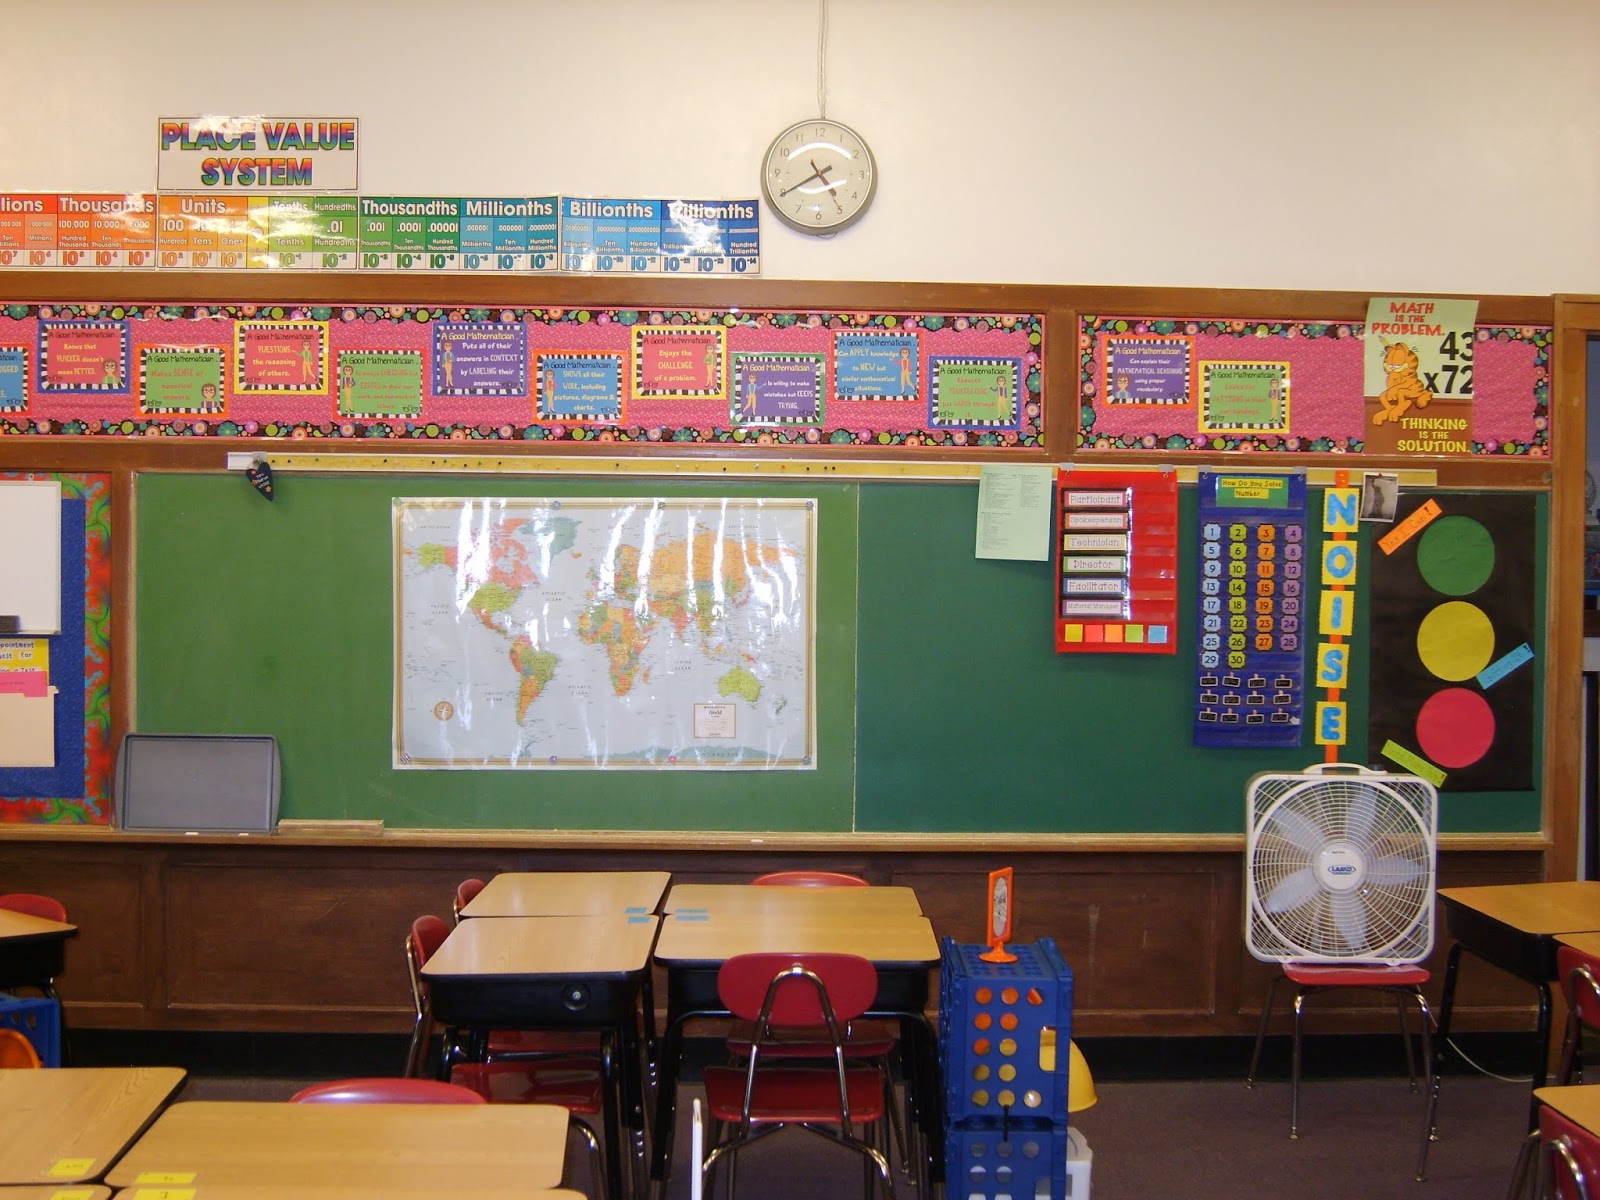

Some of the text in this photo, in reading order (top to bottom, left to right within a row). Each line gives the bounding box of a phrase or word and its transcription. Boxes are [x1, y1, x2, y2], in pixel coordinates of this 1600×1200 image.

[161, 122, 355, 150] PLACE VALUE
[796, 133, 804, 142] 11
[815, 128, 826, 138] 12
[780, 148, 790, 157] 10
[853, 149, 859, 159] 2
[201, 158, 313, 186] SYSTEM
[774, 168, 781, 177] 9
[859, 170, 865, 180] 3
[851, 191, 858, 200] 4
[60, 197, 154, 213] Thousands
[181, 198, 227, 214] Units
[314, 203, 357, 212] Hundredths
[362, 199, 458, 215] Thousandths
[466, 200, 553, 216] Millionths
[570, 201, 654, 218] Billionths
[795, 204, 802, 214] 7
[667, 202, 755, 219] Trillionths
[836, 206, 843, 215] 5
[815, 211, 822, 220] 6
[163, 219, 185, 232] 100
[327, 221, 343, 233] .01
[367, 222, 385, 232] .001
[397, 222, 422, 233] .0001
[427, 222, 458, 233] .00001
[159, 237, 188, 245] Hundreds
[193, 237, 213, 245] Tens
[276, 238, 305, 246] Tenths
[314, 238, 356, 246] Hundredths
[1390, 302, 1434, 314] MATH
[1395, 314, 1426, 323] IS THE
[1371, 322, 1446, 336] PROBLEM.
[441, 332, 447, 340] A
[257, 345, 291, 353] QUESTIONS
[1439, 331, 1473, 362] 43
[659, 349, 680, 358] Enjoys
[265, 359, 296, 367] reasoning
[658, 361, 693, 369] CHALLENGE
[469, 367, 497, 375] LABELING
[1424, 365, 1473, 394] x72
[1401, 417, 1468, 430] THINKING
[1419, 431, 1449, 439] IS THE
[1397, 440, 1471, 453] SOLUTION.
[1070, 494, 1121, 506] Participant
[1070, 516, 1122, 526] Spokesperson
[1235, 528, 1241, 537] 2
[1263, 529, 1269, 537] 3
[1290, 529, 1296, 537] 4
[1070, 537, 1120, 548] Technician
[1209, 546, 1215, 554] 5
[1235, 547, 1241, 555] 6
[1264, 548, 1269, 556] 7
[1290, 548, 1296, 556] 8
[1073, 559, 1114, 569] Director
[1209, 564, 1216, 573] 9
[1233, 565, 1243, 573] 10
[1262, 566, 1269, 574] 11
[1288, 567, 1297, 575] 12
[1069, 581, 1119, 592] Facilitator
[1206, 582, 1216, 591] 13
[1232, 583, 1242, 591] 14
[1261, 584, 1270, 592] 15
[1287, 584, 1296, 592] 16
[1207, 601, 1216, 609] 17
[1233, 601, 1242, 609] 18
[1260, 601, 1269, 609] 19
[1285, 602, 1296, 610] 20
[1207, 619, 1217, 628] 21
[1233, 619, 1244, 628] 22
[1260, 620, 1270, 628] 23
[1284, 620, 1295, 628] 24
[1206, 638, 1217, 646] 25
[1231, 638, 1242, 646] 26
[1258, 638, 1269, 646] 27
[1283, 638, 1294, 646] 28
[1205, 655, 1216, 664] 29
[1231, 655, 1242, 664] 30
